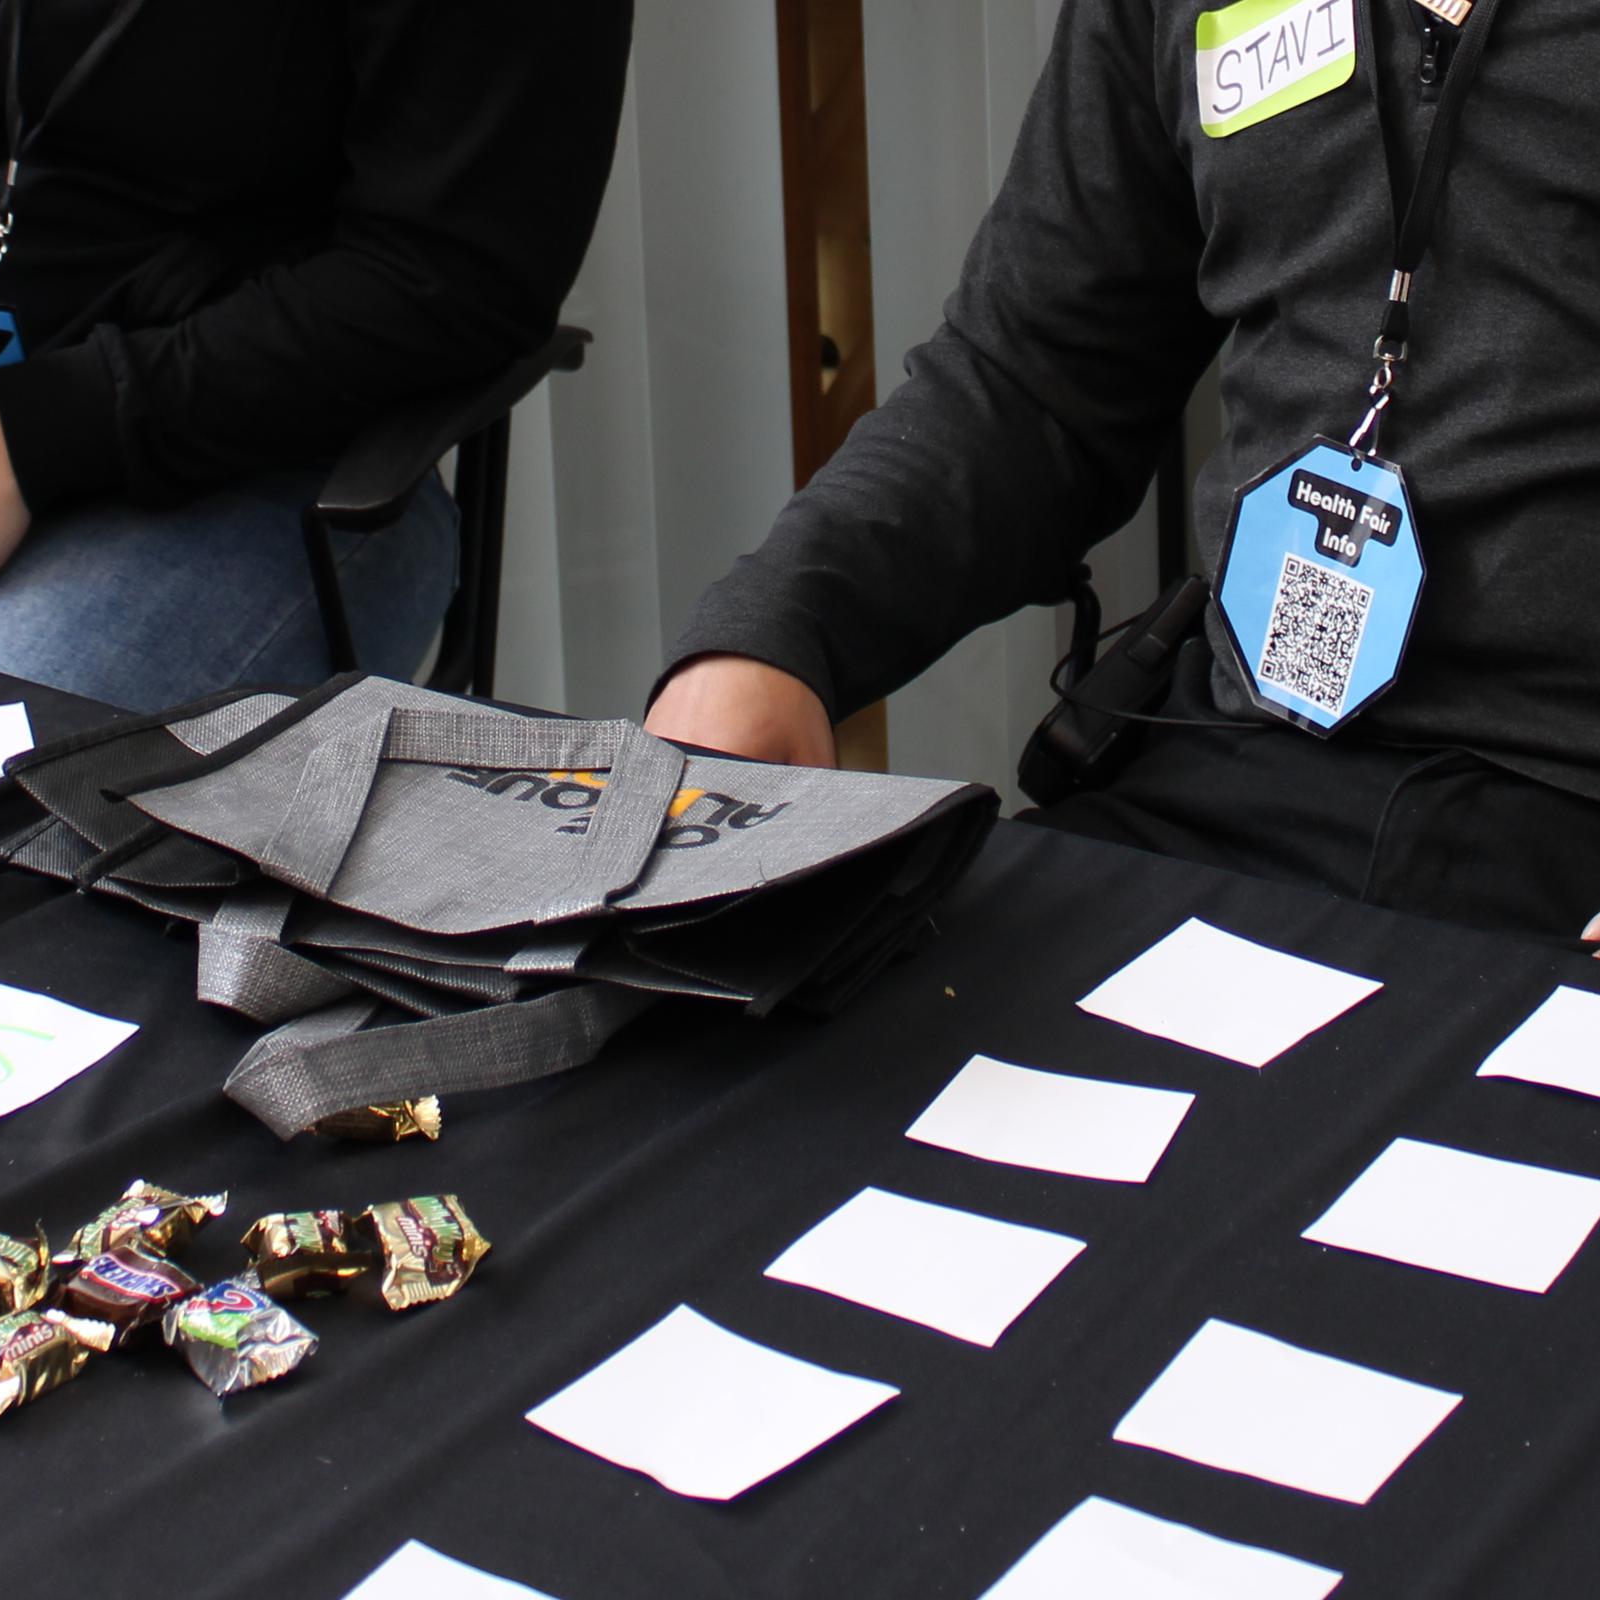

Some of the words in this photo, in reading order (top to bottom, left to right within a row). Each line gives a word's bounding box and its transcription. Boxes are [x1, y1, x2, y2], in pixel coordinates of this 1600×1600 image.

[1296, 480, 1356, 521] Health
[1358, 507, 1393, 535] Fair
[1322, 528, 1358, 558] Info
[396, 1215, 429, 1259] minis
[4, 1321, 54, 1362] minis
